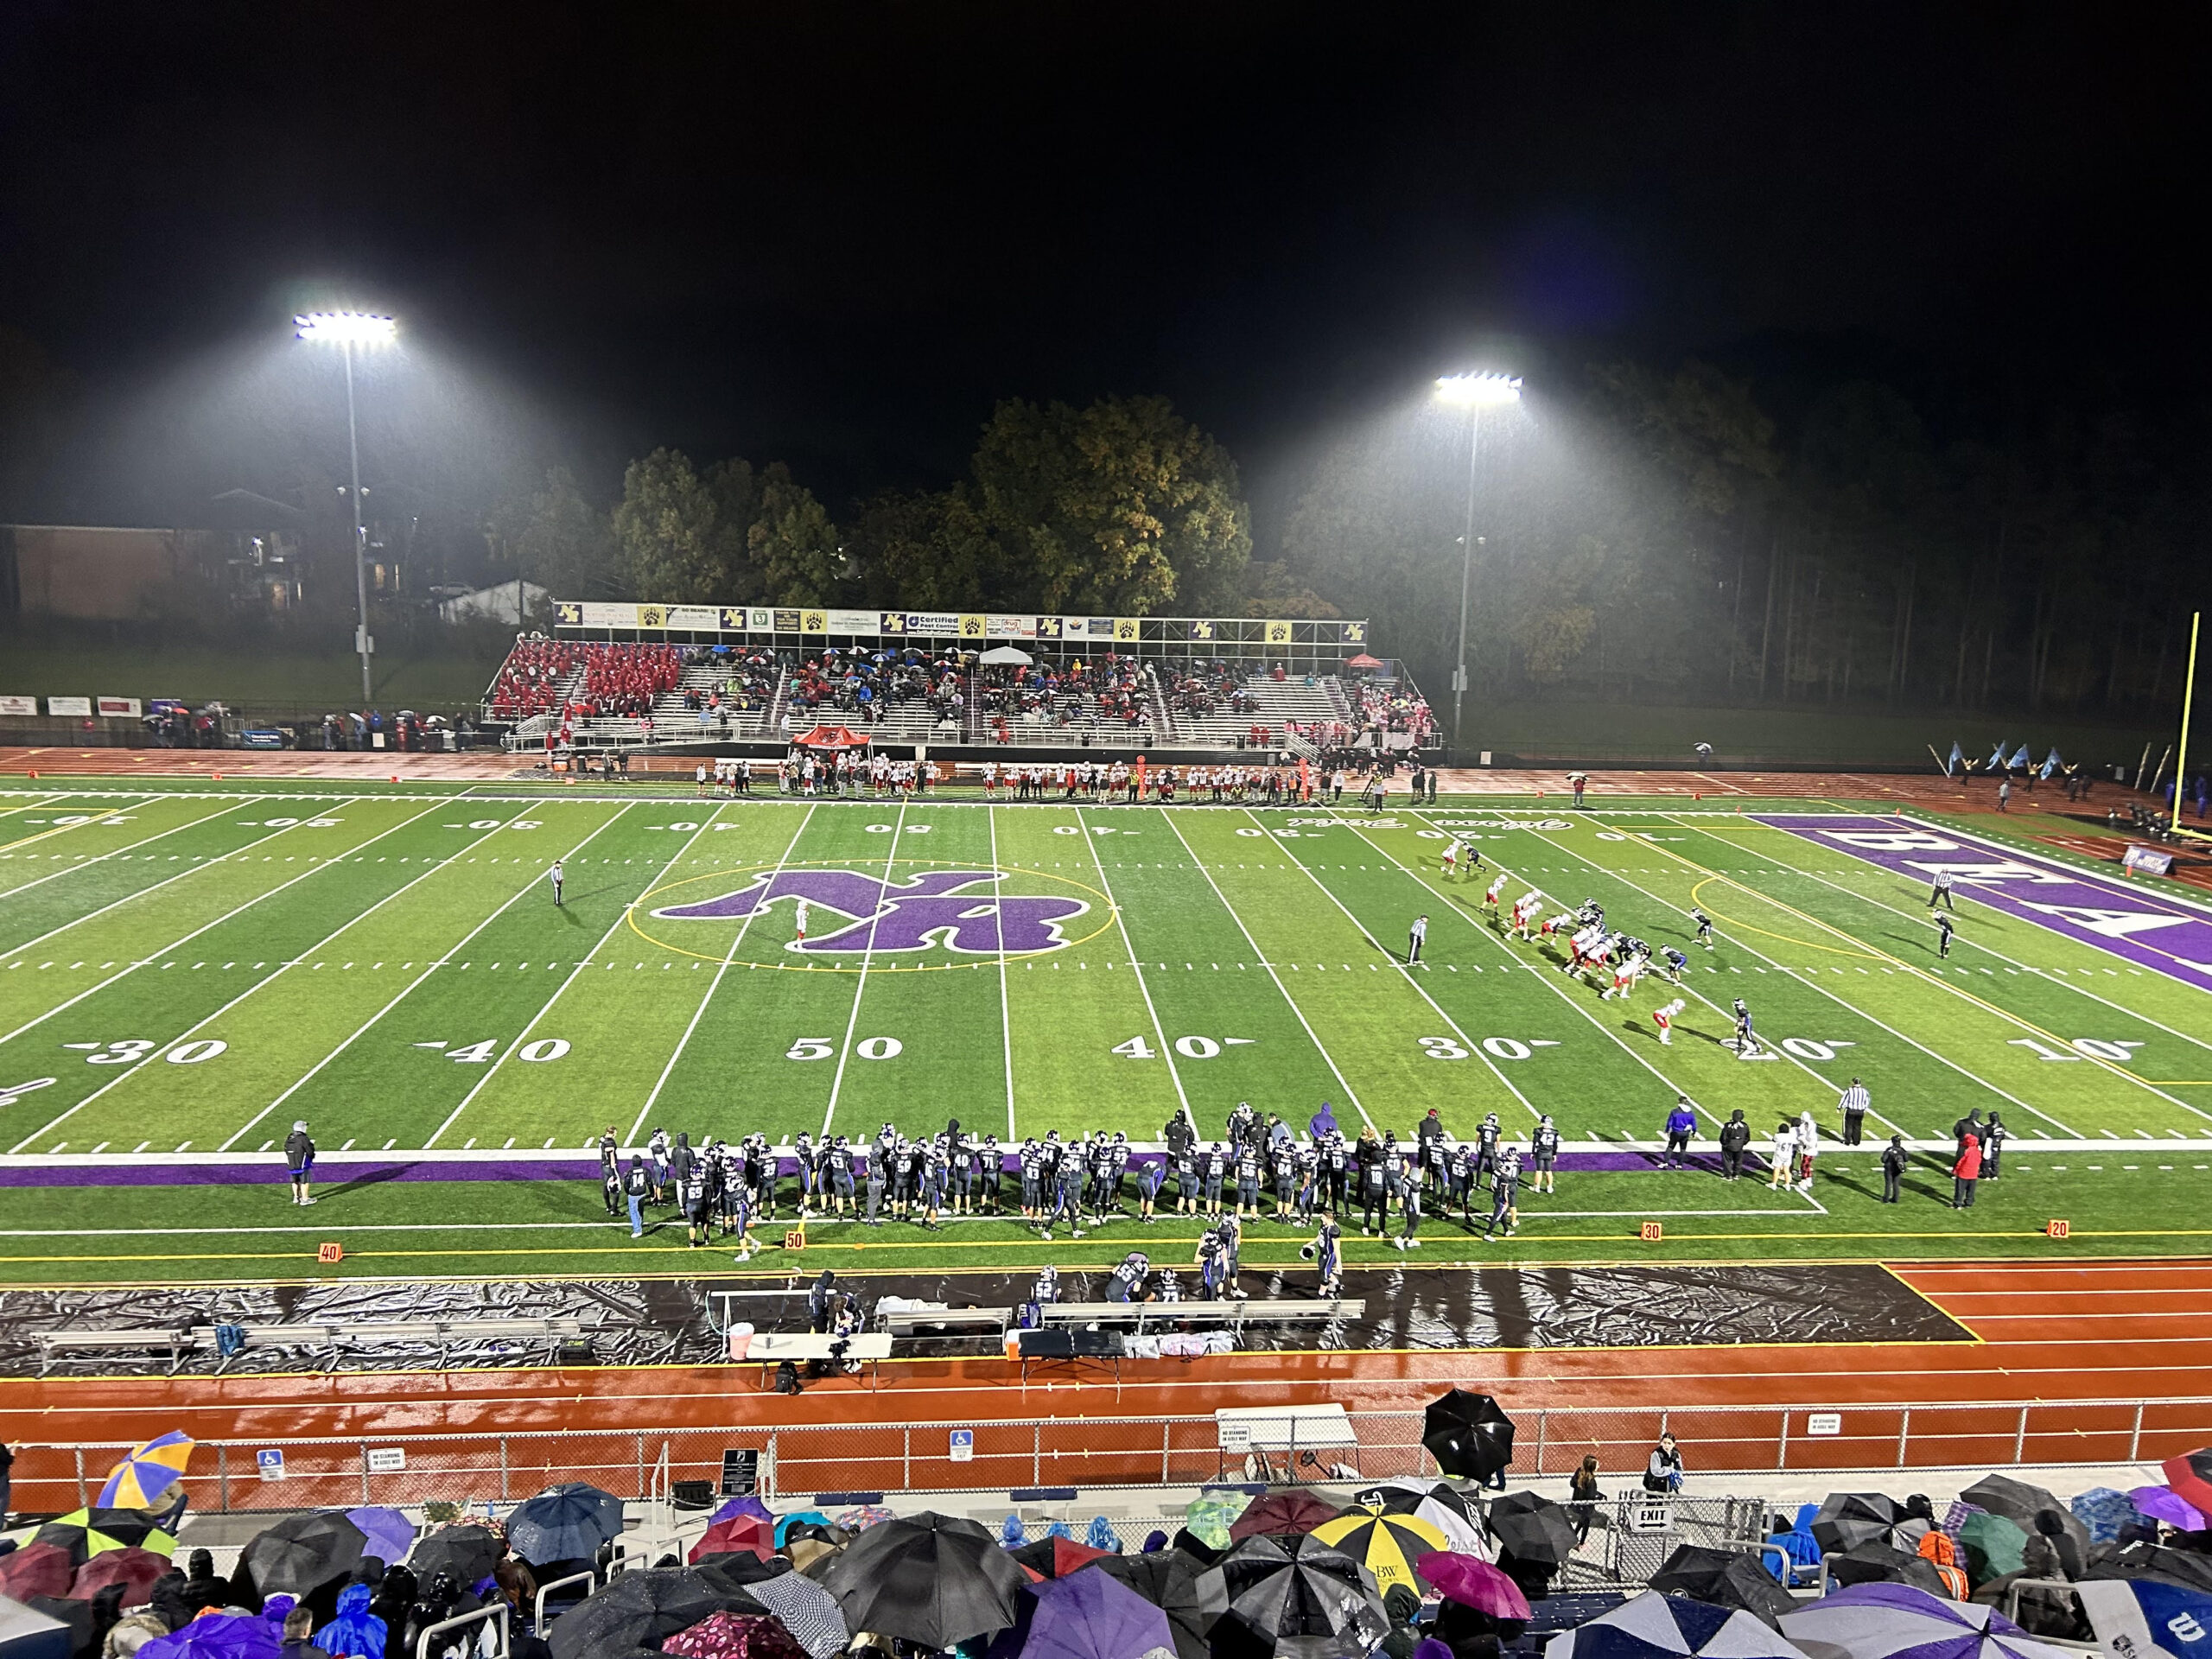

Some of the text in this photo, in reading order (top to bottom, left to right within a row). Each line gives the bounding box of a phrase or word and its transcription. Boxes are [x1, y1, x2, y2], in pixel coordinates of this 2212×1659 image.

[86, 1039, 228, 1065] 30
[445, 1038, 571, 1064] 40
[785, 1037, 903, 1061] 50
[1111, 1034, 1221, 1059] 40
[1417, 1036, 1532, 1061] 30
[2007, 1038, 2134, 1061] 10
[1484, 1130, 1492, 1142] 9
[1541, 1133, 1555, 1146] 42
[1781, 1142, 1792, 1152] 67
[954, 1154, 969, 1166] 40
[983, 1156, 994, 1168] 71
[1332, 1155, 1344, 1168] 13
[1097, 1166, 1111, 1179] 47
[1371, 1171, 1382, 1185] 18
[1452, 1165, 1466, 1178] 65
[632, 1173, 645, 1187] 14
[688, 1186, 703, 1199] 69
[1645, 1224, 1661, 1239] 30
[2053, 1223, 2067, 1236] 20
[787, 1232, 802, 1248] 50
[321, 1245, 337, 1261] 40
[1117, 1262, 1137, 1282] 55
[1036, 1282, 1052, 1298] 52
[1641, 1510, 1666, 1521] EXIT
[1376, 1565, 1398, 1578] BW
